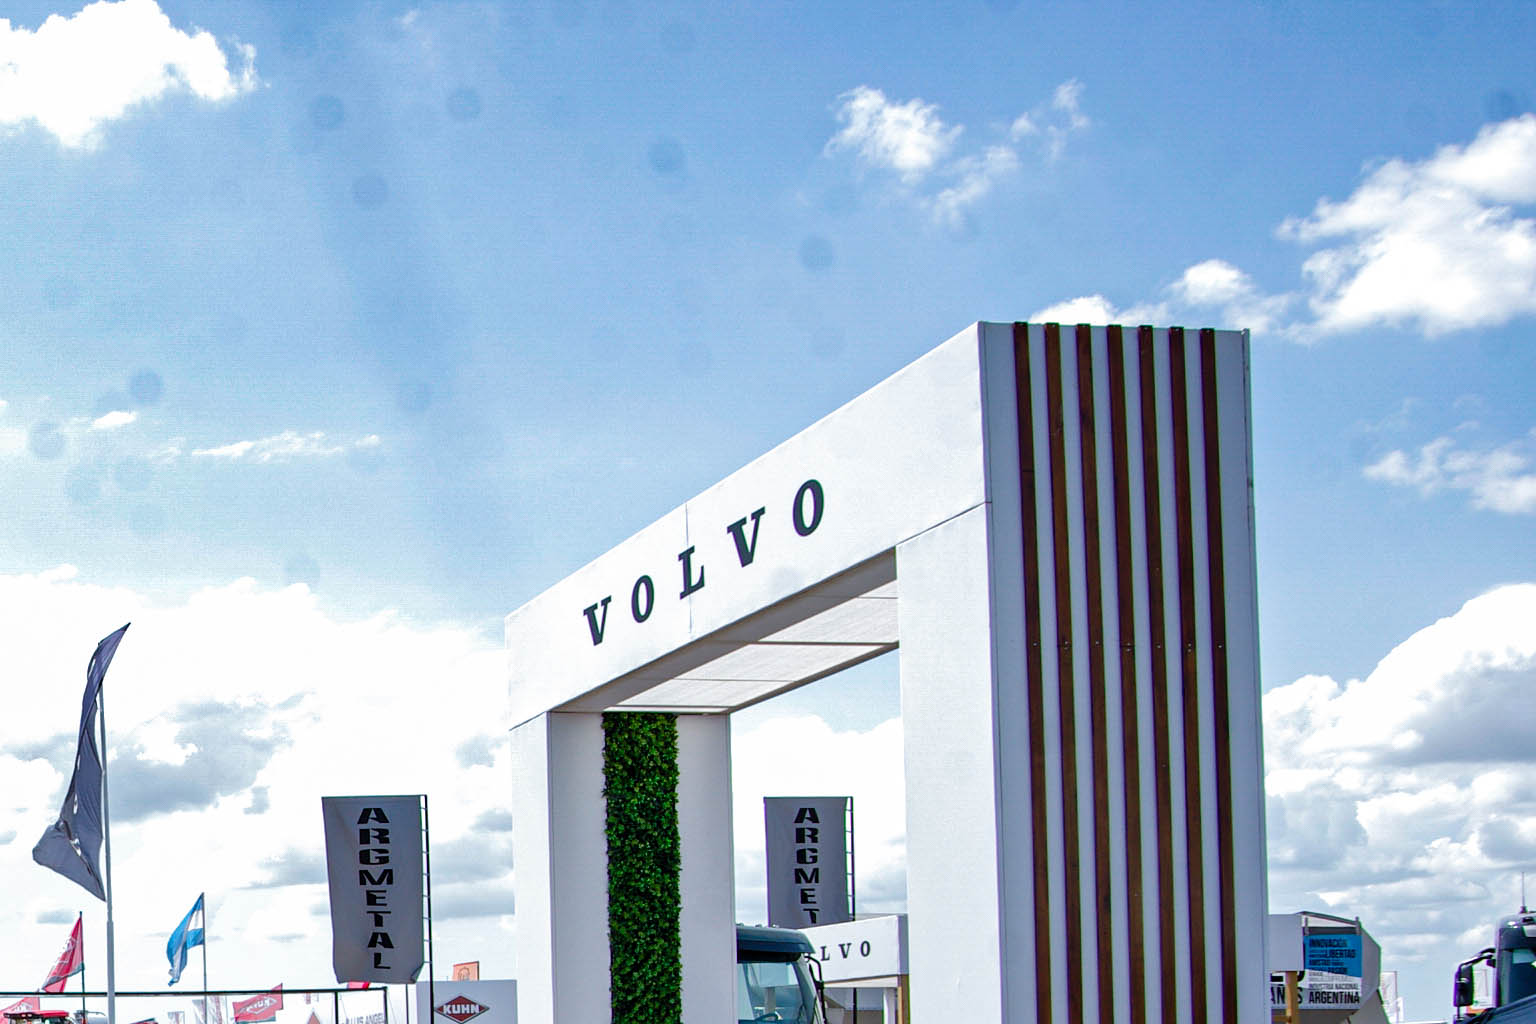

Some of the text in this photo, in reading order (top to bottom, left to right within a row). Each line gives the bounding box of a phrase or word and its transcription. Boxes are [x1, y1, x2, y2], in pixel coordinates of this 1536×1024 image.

[582, 478, 825, 647] VOLVO
[357, 807, 394, 970] ARGMETAL
[443, 1004, 480, 1015] KUHN
[1308, 991, 1360, 1005] ARGENTINA
